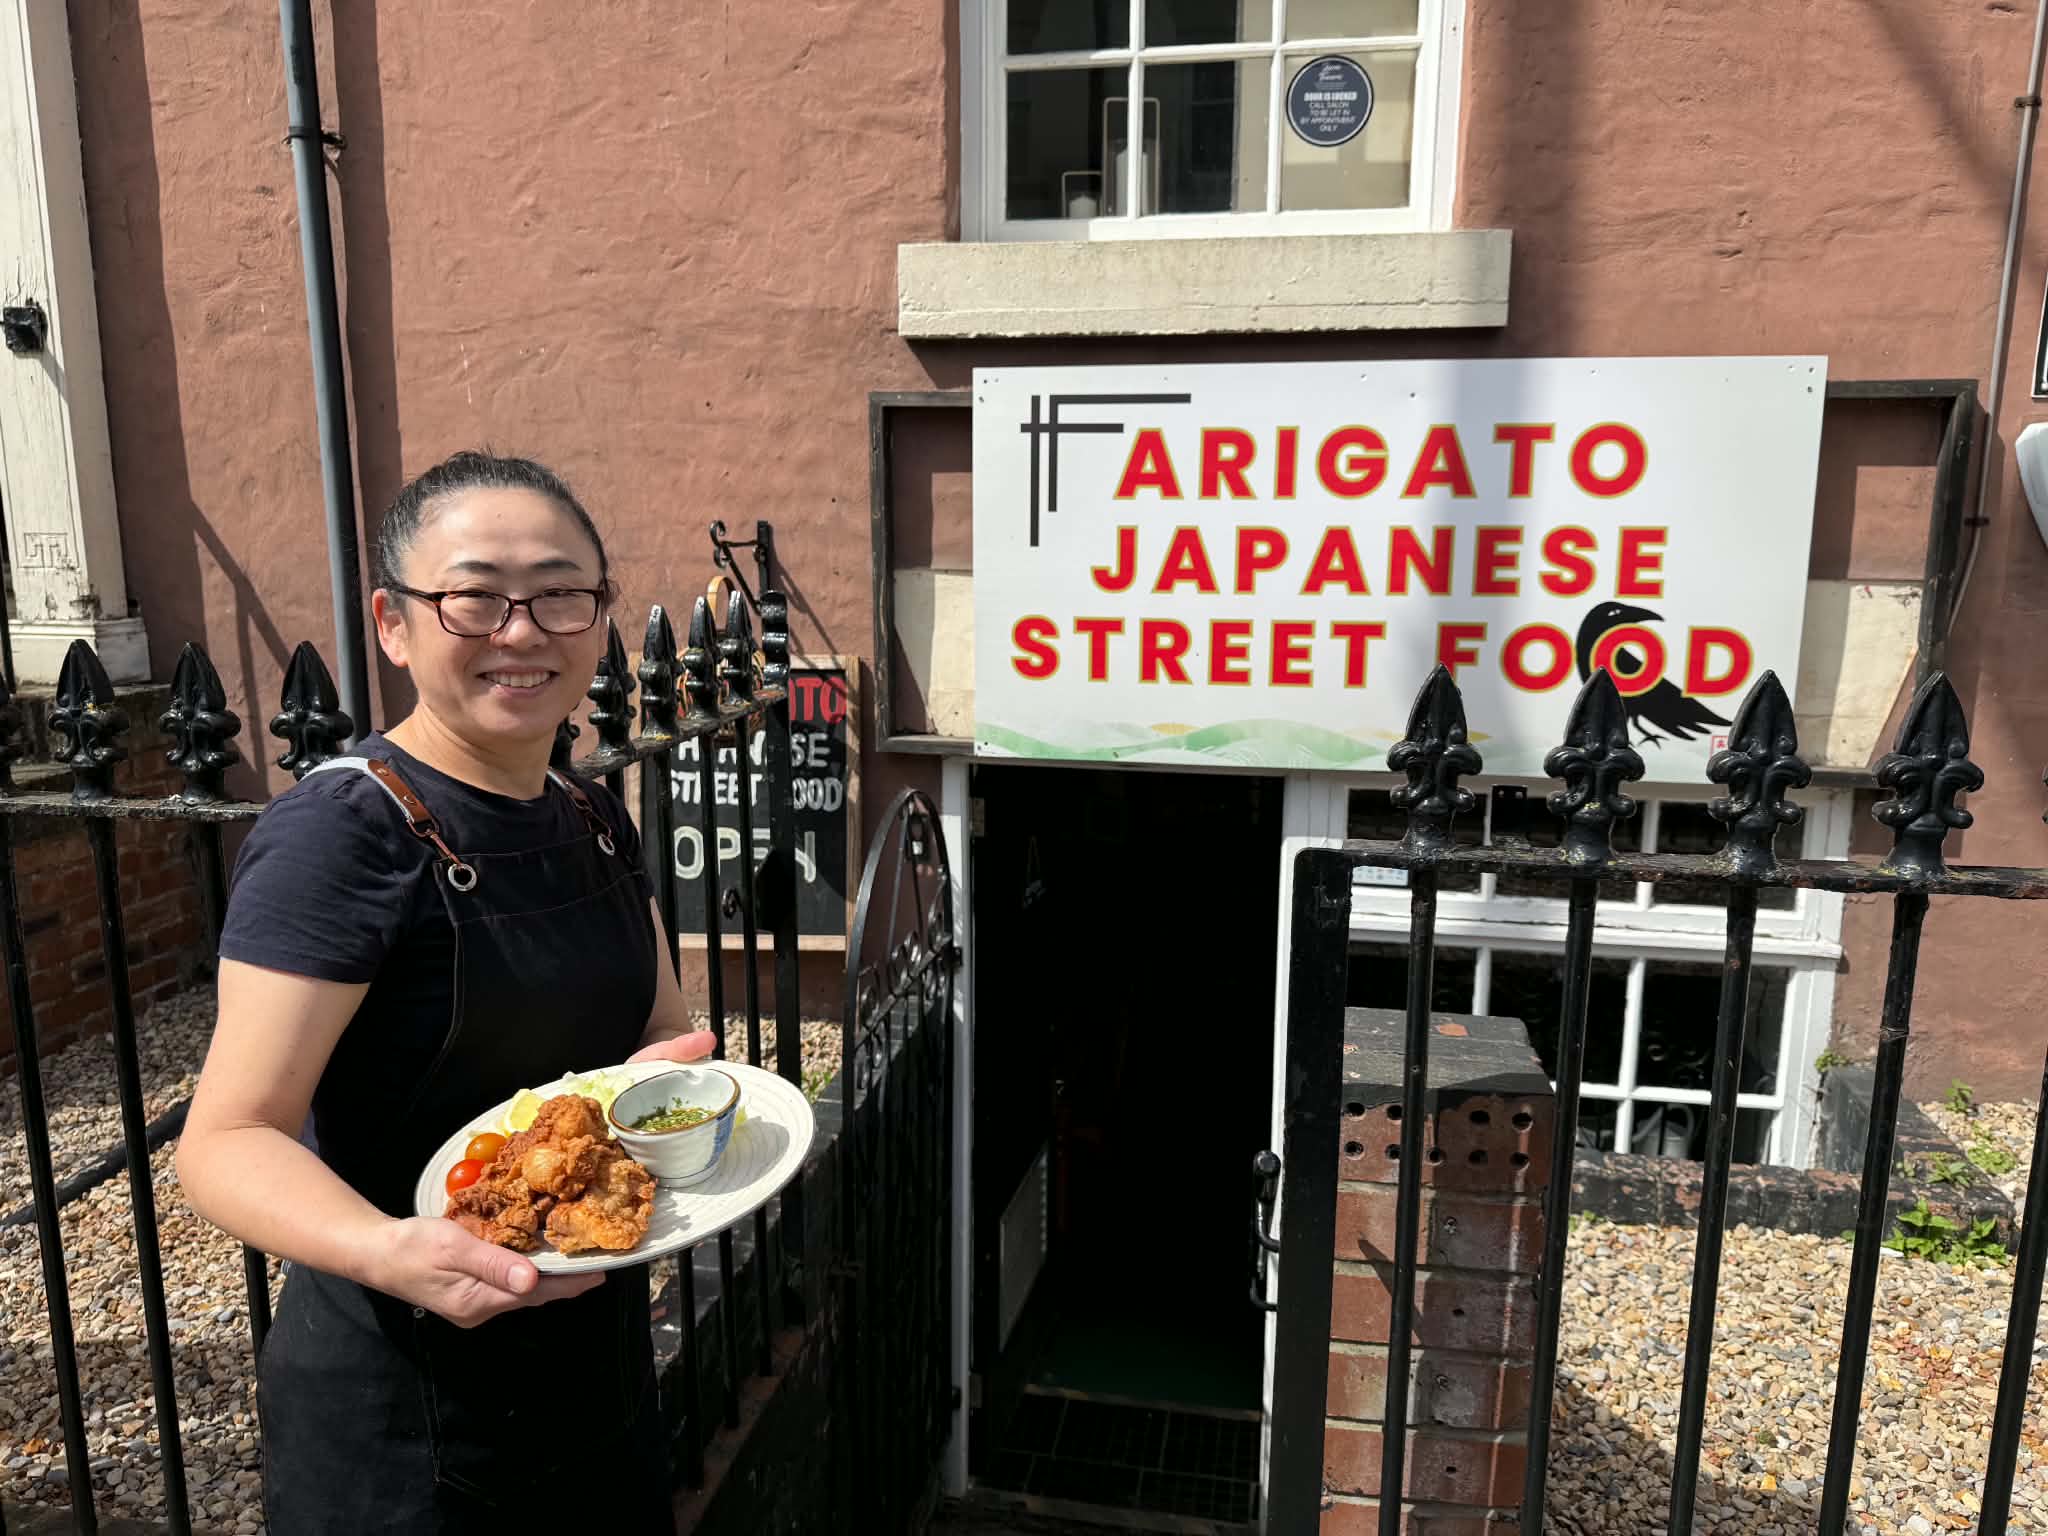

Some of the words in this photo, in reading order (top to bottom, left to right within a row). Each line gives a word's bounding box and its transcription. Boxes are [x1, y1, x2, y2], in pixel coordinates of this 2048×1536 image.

[1112, 420, 1650, 501] ARIGATO
[1089, 524, 1669, 601] JAPANESE
[1009, 613, 1388, 690] STREET
[1434, 620, 1756, 700] FOOD
